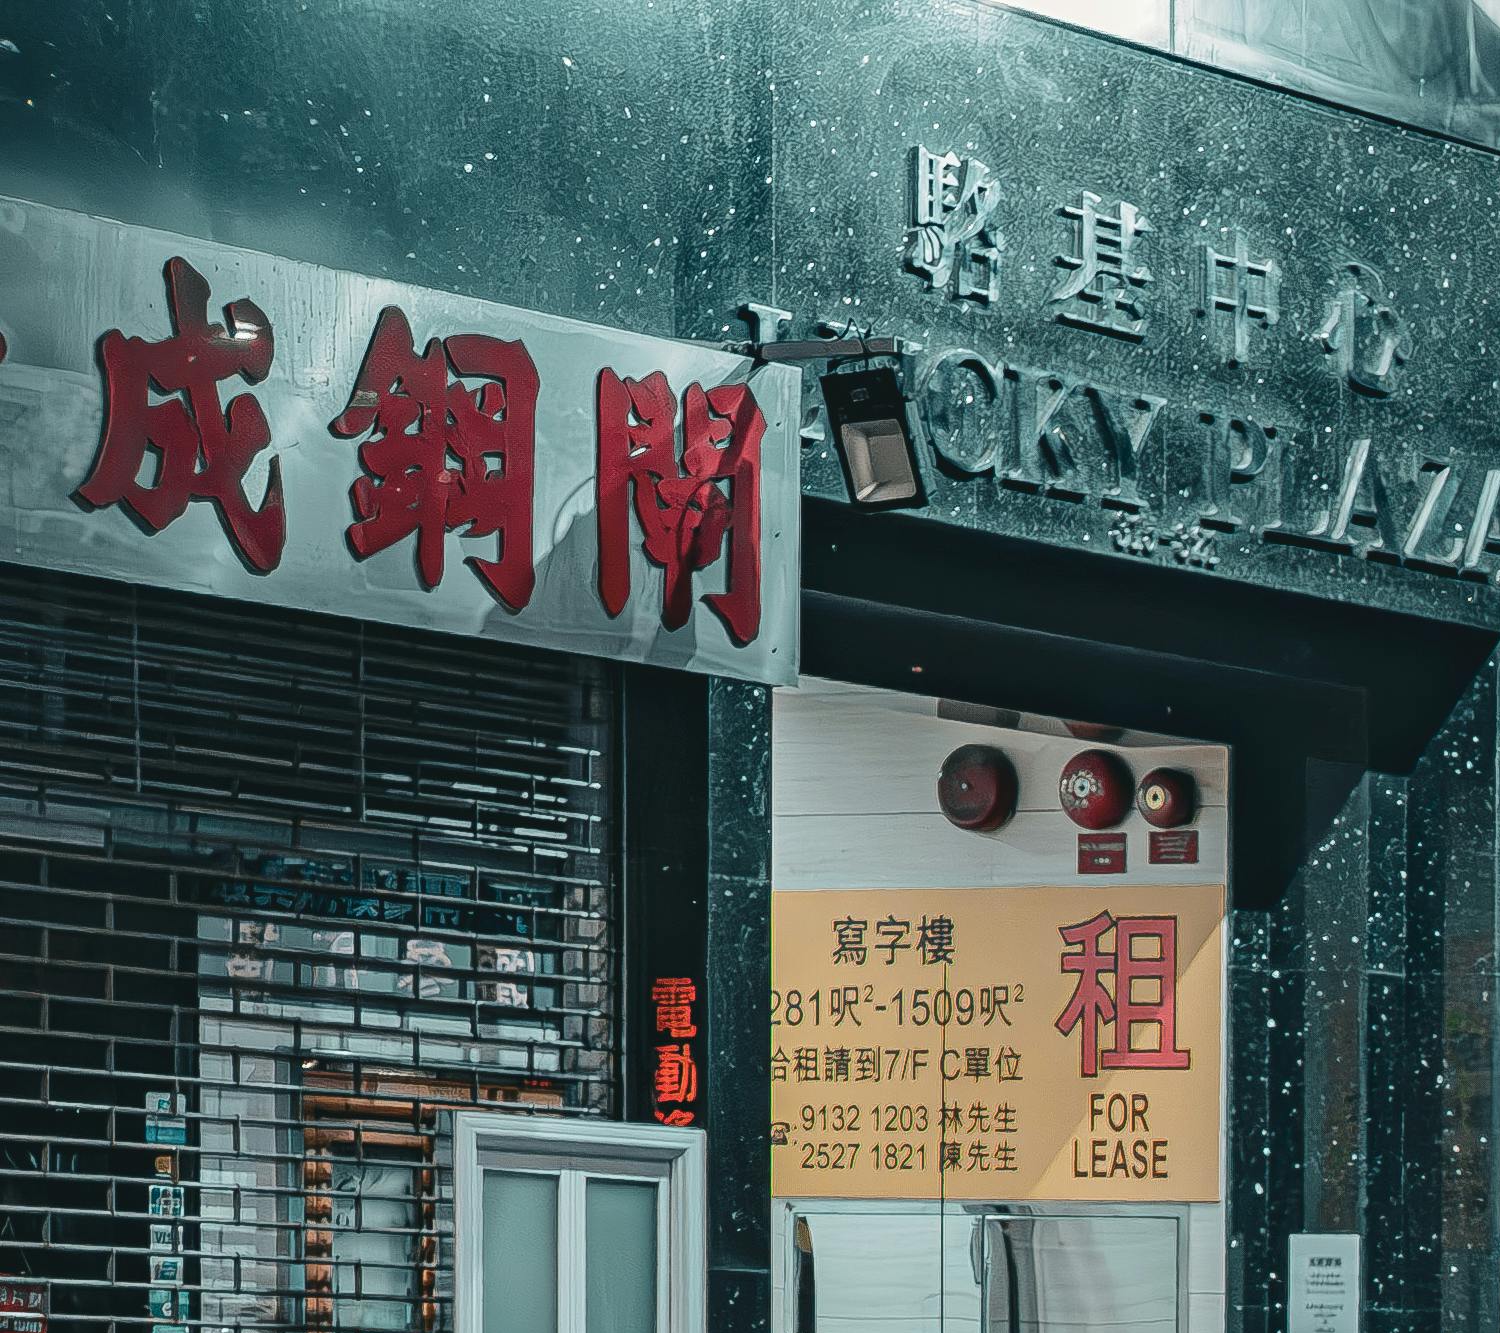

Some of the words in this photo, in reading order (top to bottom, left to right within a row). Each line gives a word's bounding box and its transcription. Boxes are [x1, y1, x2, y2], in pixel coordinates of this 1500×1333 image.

[0, 257, 768, 646] 成鋼閘
[875, 340, 1168, 516] OKY
[831, 913, 957, 966] 寫字樓
[1054, 908, 1192, 1079] 租
[800, 1103, 861, 1133] 9132
[871, 1103, 929, 1133] 1203
[938, 1101, 1019, 1135] 林先生
[1088, 1092, 1150, 1133] FOR
[800, 1142, 858, 1171] 2527
[871, 1142, 927, 1171] 1821
[939, 1140, 1019, 1173] 陳先生
[1072, 1138, 1170, 1179] LEASE
